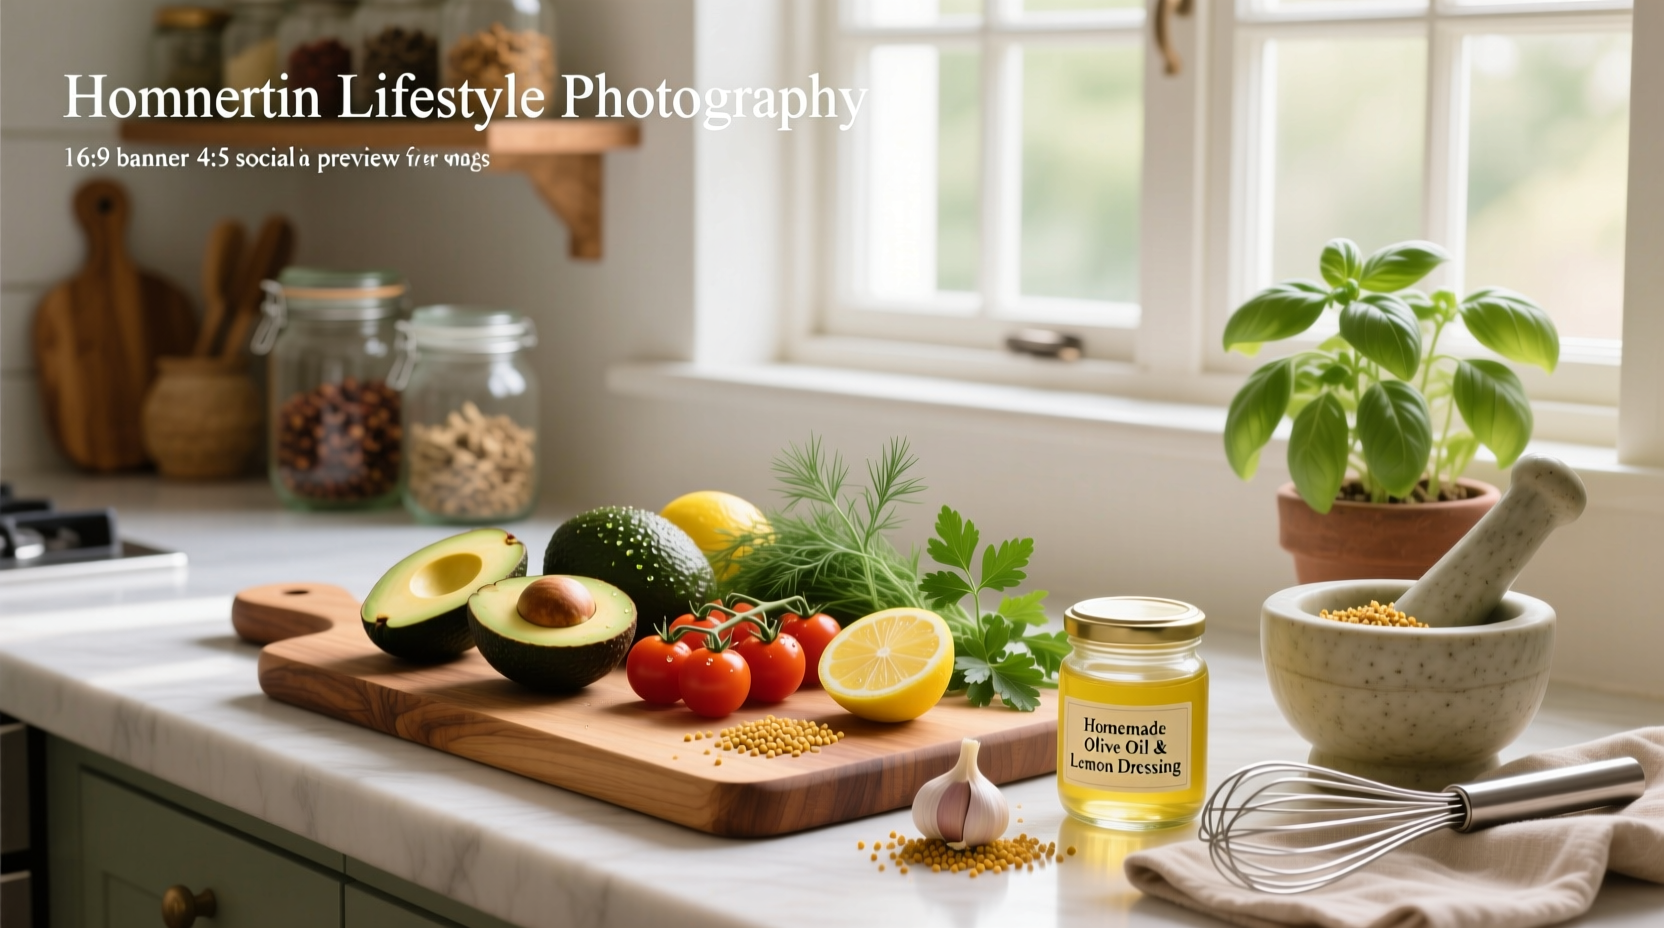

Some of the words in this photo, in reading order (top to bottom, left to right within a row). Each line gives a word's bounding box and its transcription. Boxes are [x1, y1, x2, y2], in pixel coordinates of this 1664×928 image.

[1083, 716, 1167, 736] Homemade
[1084, 736, 1121, 754] Olive
[1125, 739, 1149, 755] Oil
[1153, 739, 1167, 755] &
[1070, 752, 1114, 773] Lemon
[1117, 758, 1182, 777] Dressing
